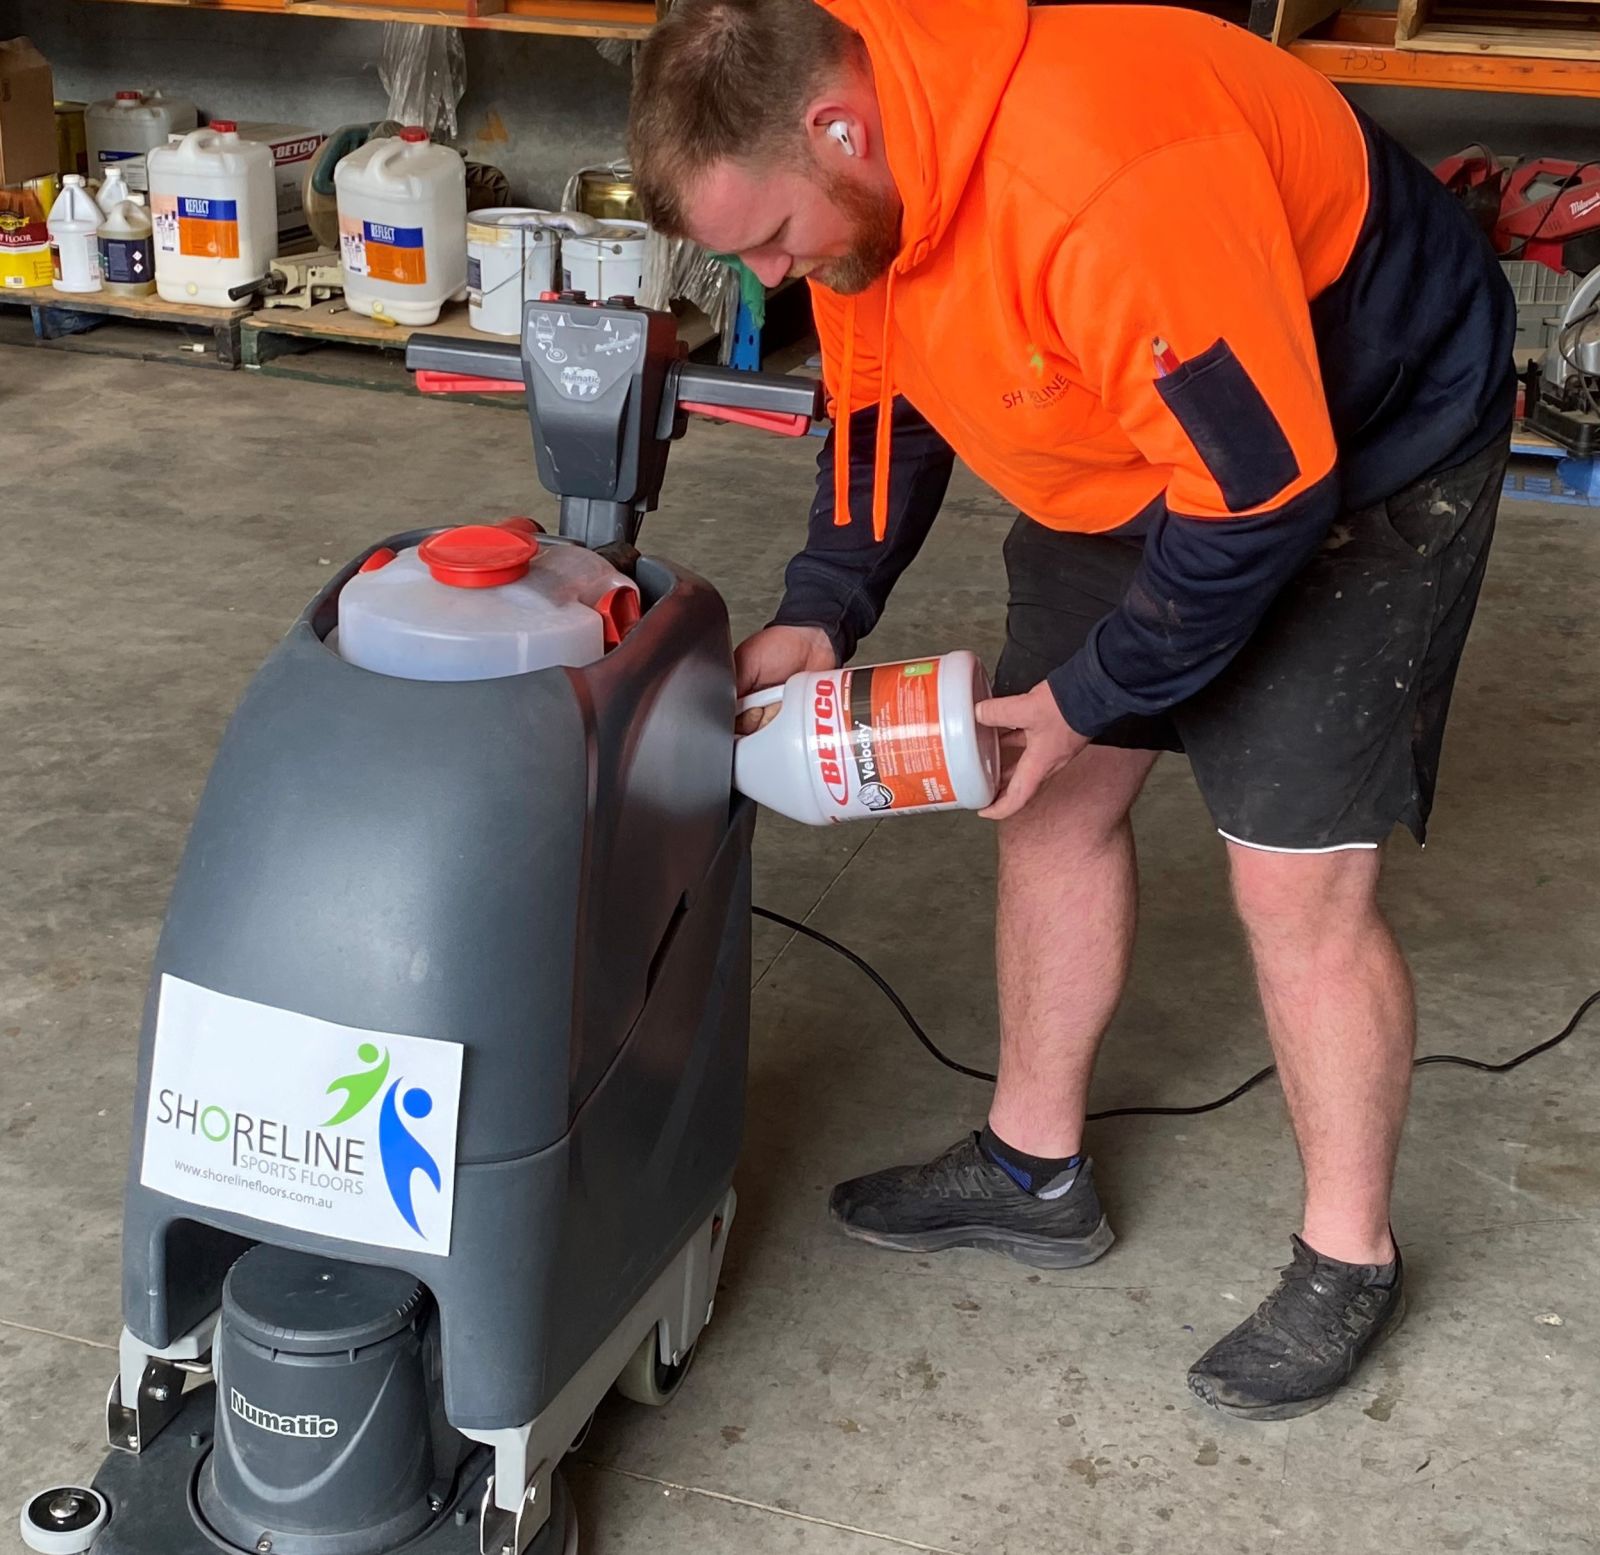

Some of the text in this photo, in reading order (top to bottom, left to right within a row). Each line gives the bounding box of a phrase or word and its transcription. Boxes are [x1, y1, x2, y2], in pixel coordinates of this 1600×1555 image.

[275, 138, 318, 159] BETCO
[184, 198, 210, 215] REFLECT
[370, 223, 396, 241] REFLECT
[814, 679, 842, 785] BETCO
[156, 1088, 367, 1176] SHORELINE
[174, 1158, 334, 1210] www.shorelinefloors.com.au
[240, 1153, 365, 1196] SPORTS FLOORS
[230, 1386, 338, 1438] Numatic
